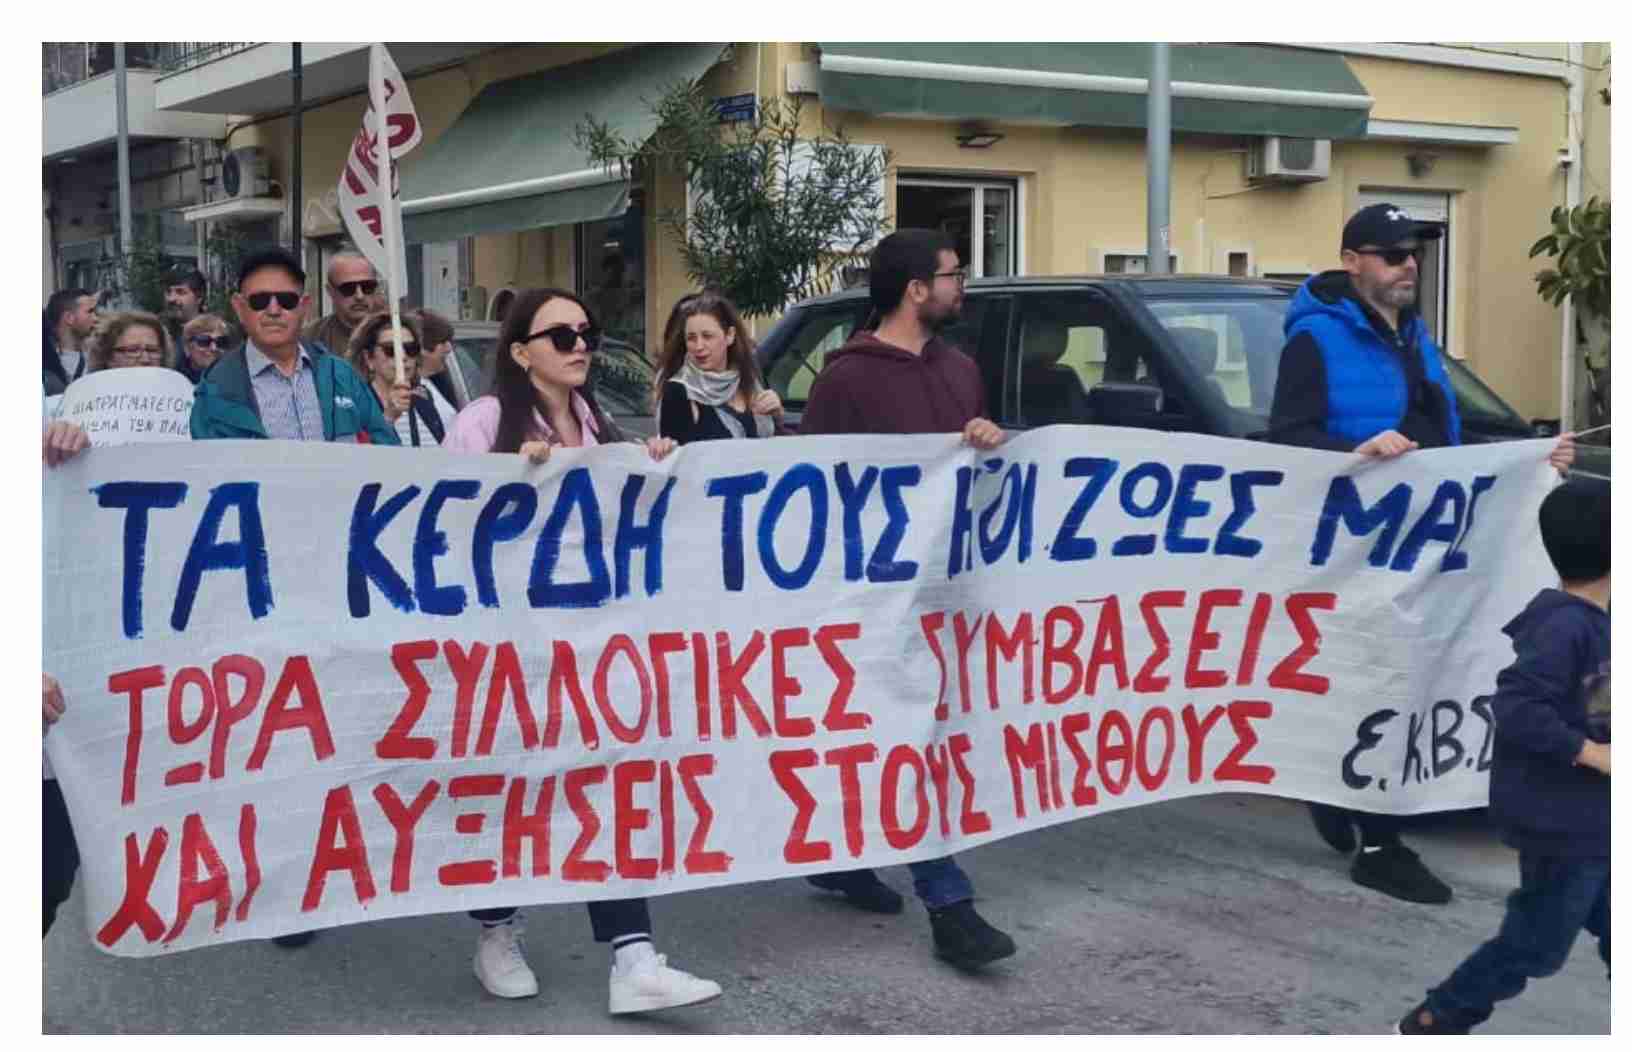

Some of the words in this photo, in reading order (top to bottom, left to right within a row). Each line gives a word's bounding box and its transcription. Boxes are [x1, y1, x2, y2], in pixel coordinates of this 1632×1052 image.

[89, 481, 275, 639] ΤΑ
[347, 467, 677, 618] ΚΕΡΔΗ
[705, 463, 922, 592] ΤΟΥΣ
[1049, 456, 1285, 561] ΖΩΕΣ
[108, 654, 336, 806] ΤΩΡΑ
[375, 624, 862, 761] ΣΥΛΛΟΓΙΚΕΣ
[301, 753, 735, 912] ΑΥΞΗΣΕΙΣ
[770, 734, 992, 863] ΣΤΟΥΣ
[1004, 701, 1275, 821] ΜΙΣΘΟΥΣ
